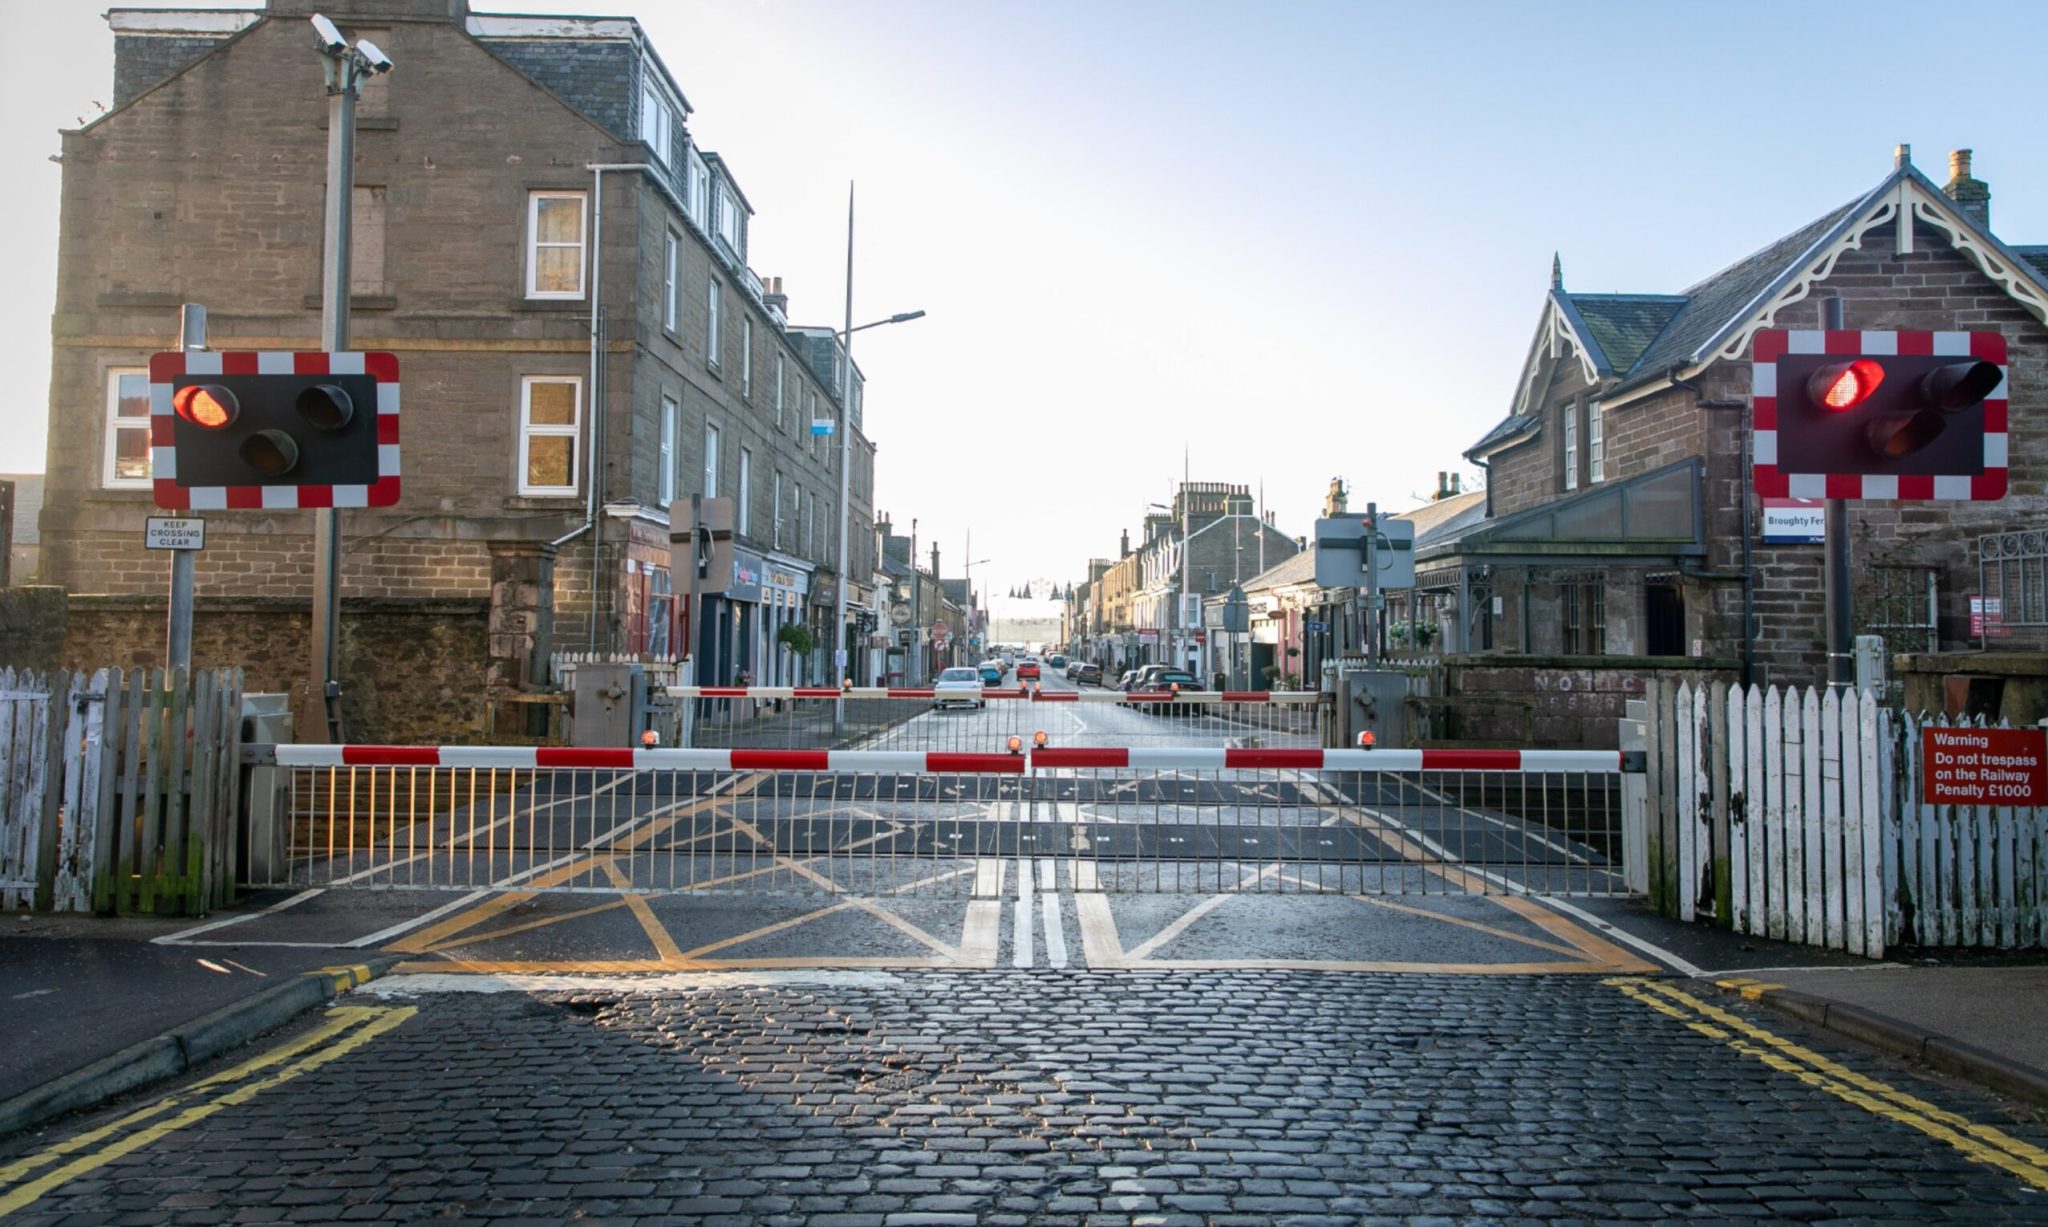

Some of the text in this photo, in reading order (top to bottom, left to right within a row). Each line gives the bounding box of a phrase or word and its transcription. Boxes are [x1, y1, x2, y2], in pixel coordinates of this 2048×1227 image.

[1768, 516, 1824, 526] Broughty Fer
[151, 529, 200, 537] CROSSING
[159, 538, 190, 546] CLEAR
[1534, 676, 1635, 692] NOTIC
[1934, 733, 1989, 749] Warning
[1935, 752, 2037, 768] Do not trespass
[1935, 768, 2030, 784] on the Railway
[1935, 783, 2031, 799] Penalty £1000
